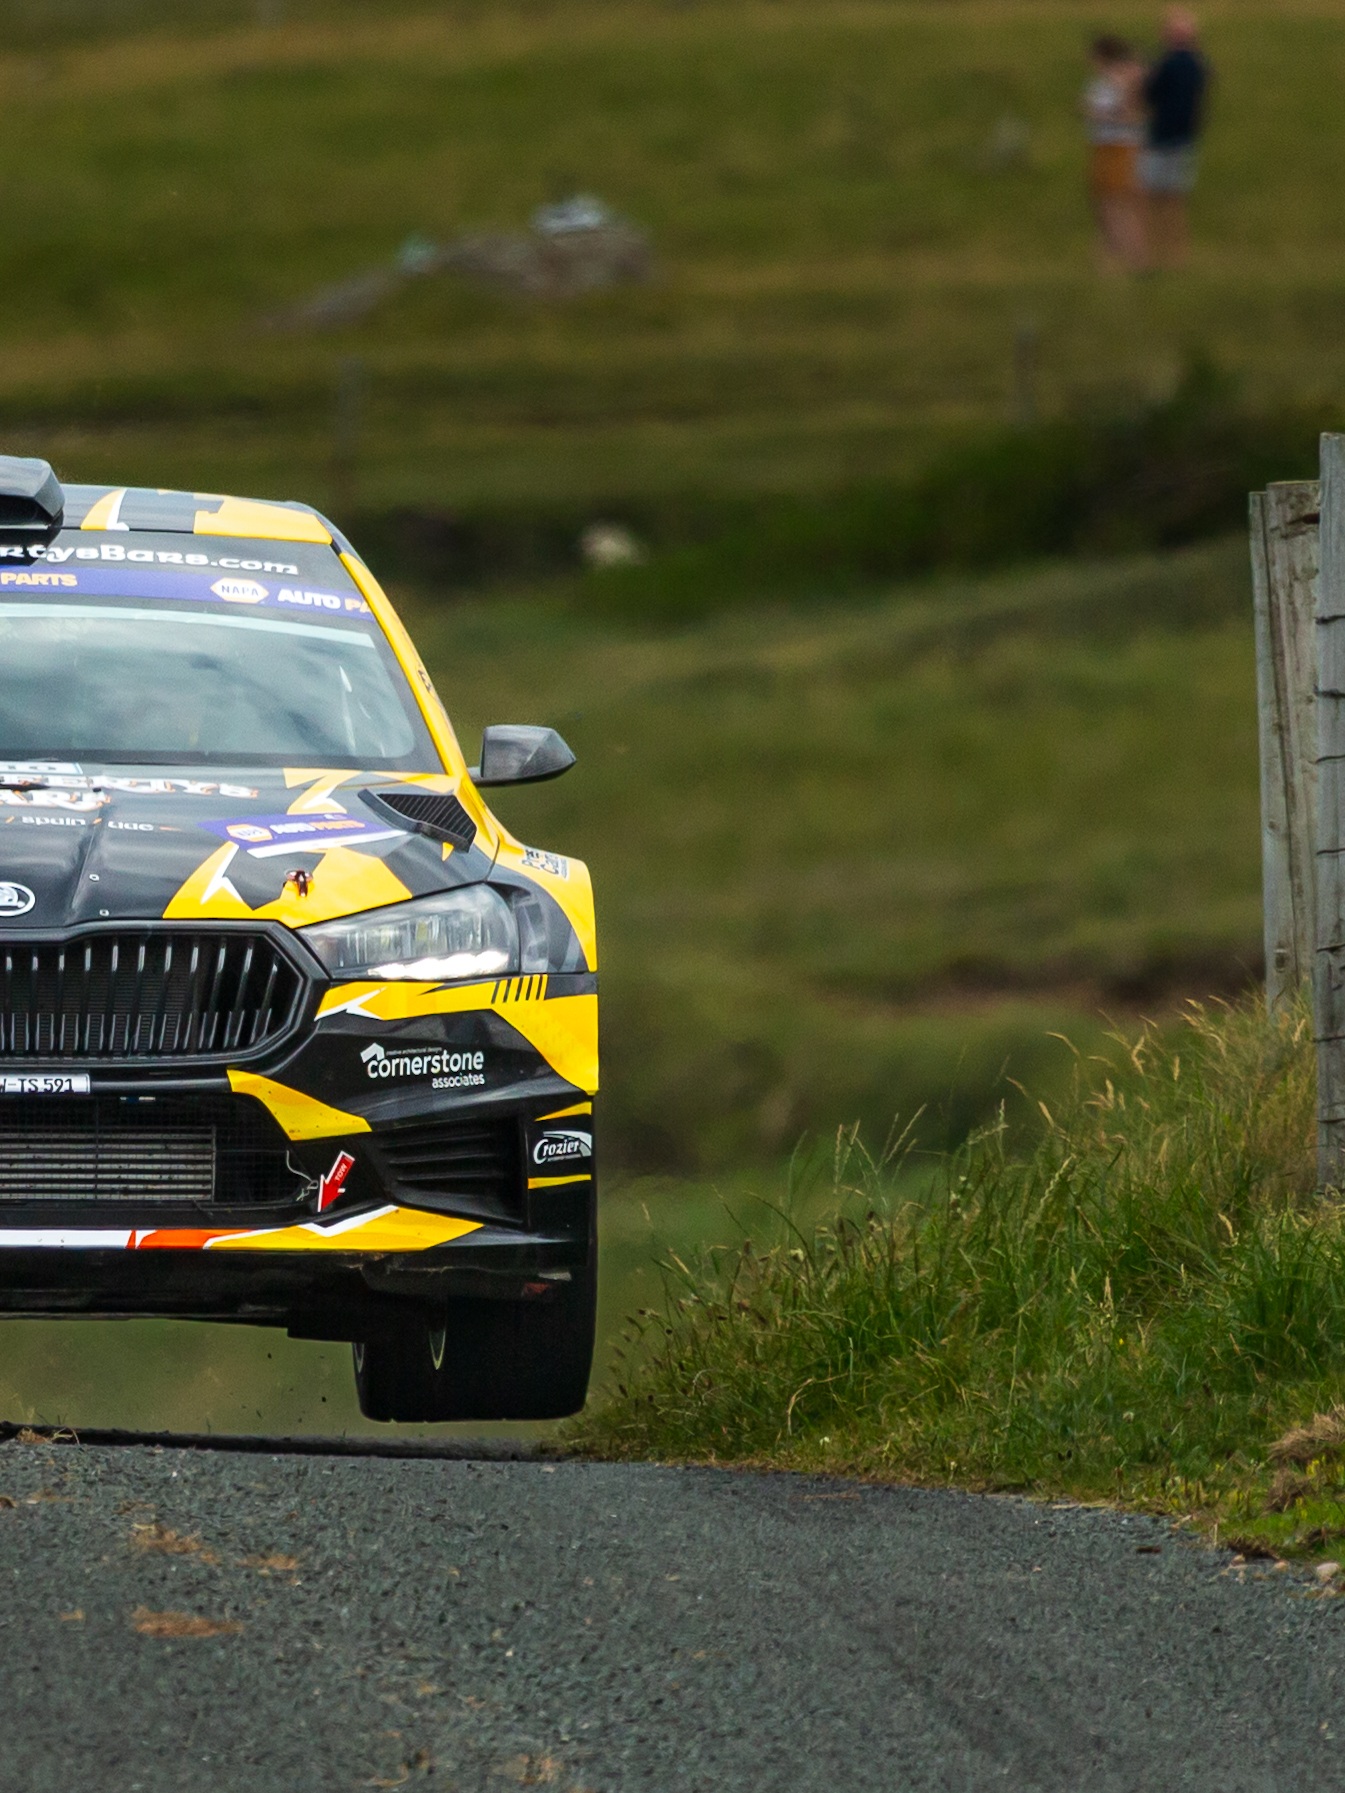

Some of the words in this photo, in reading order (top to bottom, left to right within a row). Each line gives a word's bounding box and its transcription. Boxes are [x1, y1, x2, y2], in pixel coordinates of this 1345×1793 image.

[0, 572, 78, 587] PARTS
[221, 584, 260, 596] NAPA
[277, 588, 341, 609] AUTO
[367, 1049, 485, 1078] cornerstone
[43, 1078, 74, 1093] 591
[432, 1073, 485, 1089] associates
[533, 1138, 579, 1165] Crozier
